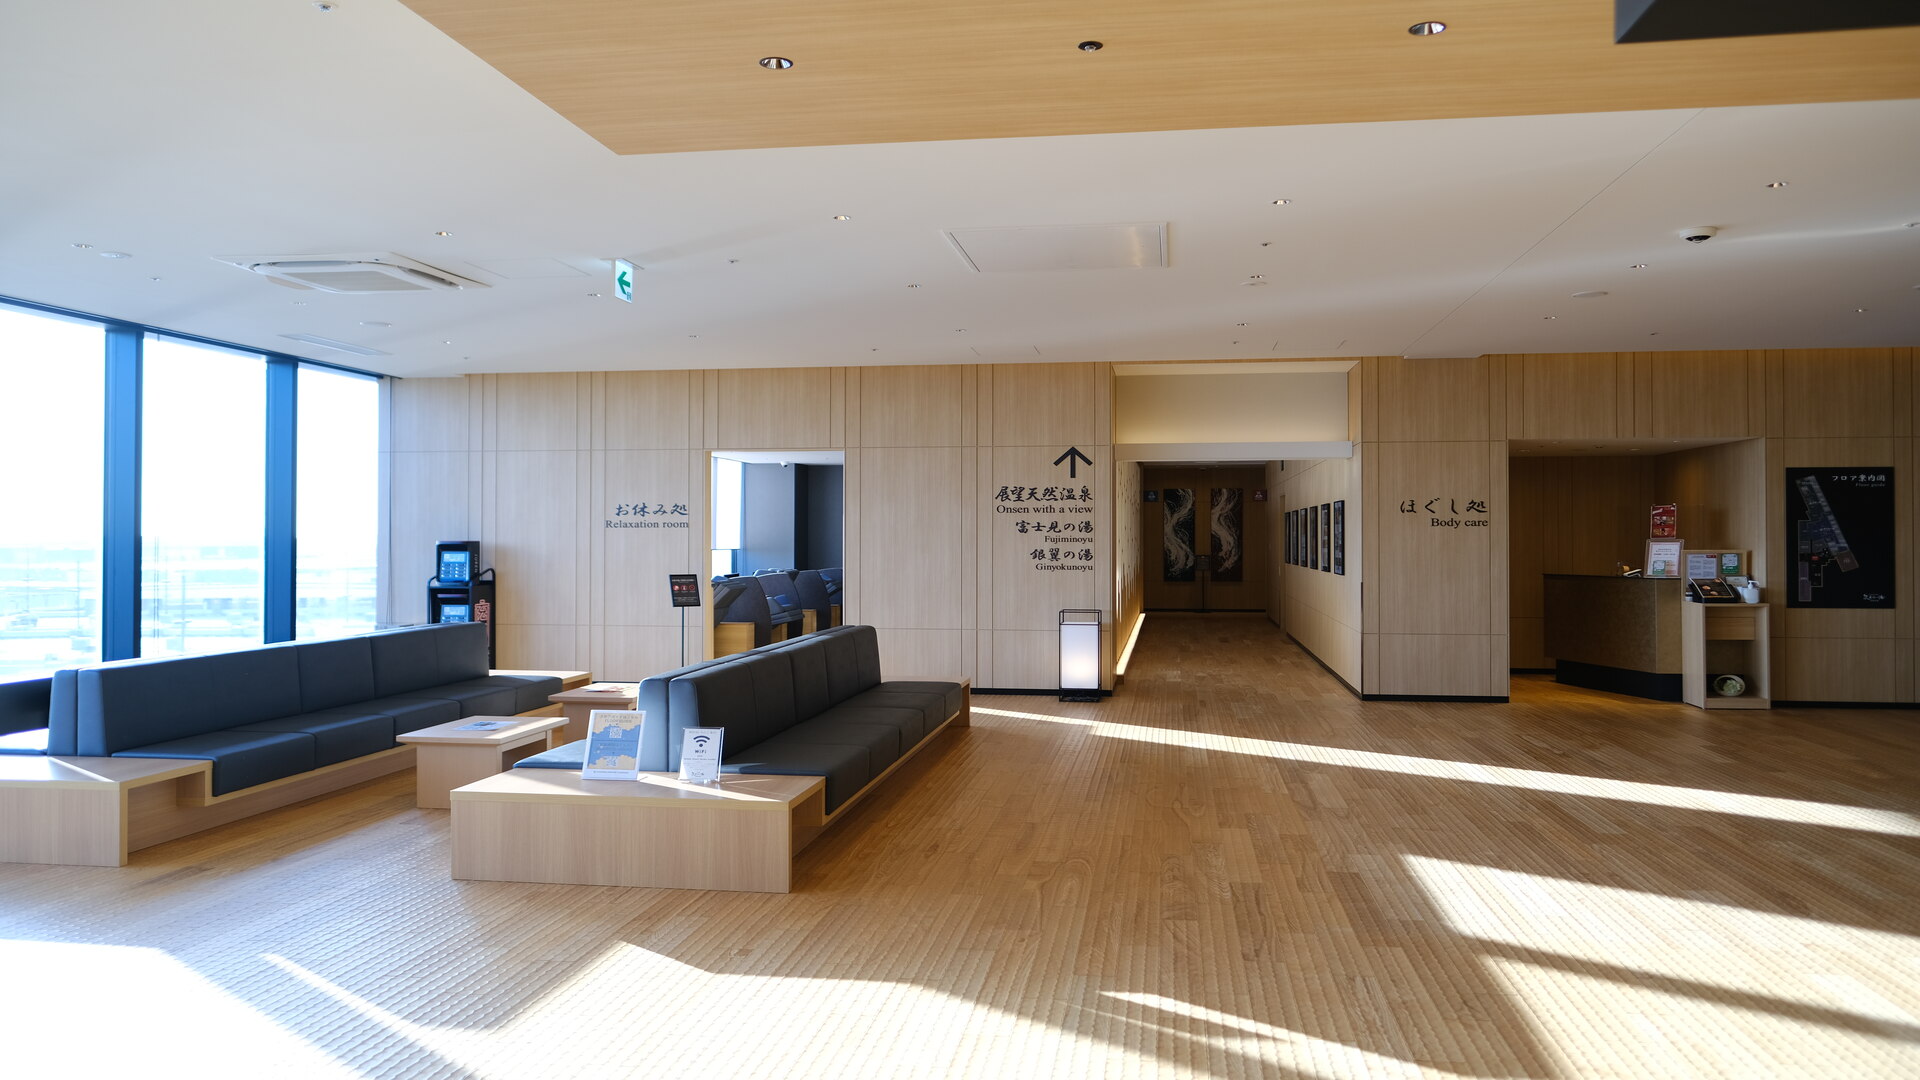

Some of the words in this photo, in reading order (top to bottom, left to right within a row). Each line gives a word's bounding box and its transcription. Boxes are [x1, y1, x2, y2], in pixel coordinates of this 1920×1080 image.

[995, 485, 1093, 502] 展望天然温泉
[615, 502, 689, 517] お休み処
[996, 504, 1029, 514] Onsen
[1033, 504, 1056, 514] with
[1068, 504, 1093, 514] view
[1400, 498, 1488, 515] ほぐし処
[605, 519, 659, 529] Relaxation
[662, 521, 689, 529] room
[1015, 520, 1093, 534] 富士見の湯
[1431, 518, 1461, 529] Body
[1464, 519, 1489, 527] care
[1044, 535, 1093, 544] Fujiminoyu
[1030, 547, 1093, 562] 銀翼の湯
[1035, 563, 1093, 572] Ginyokunoyu
